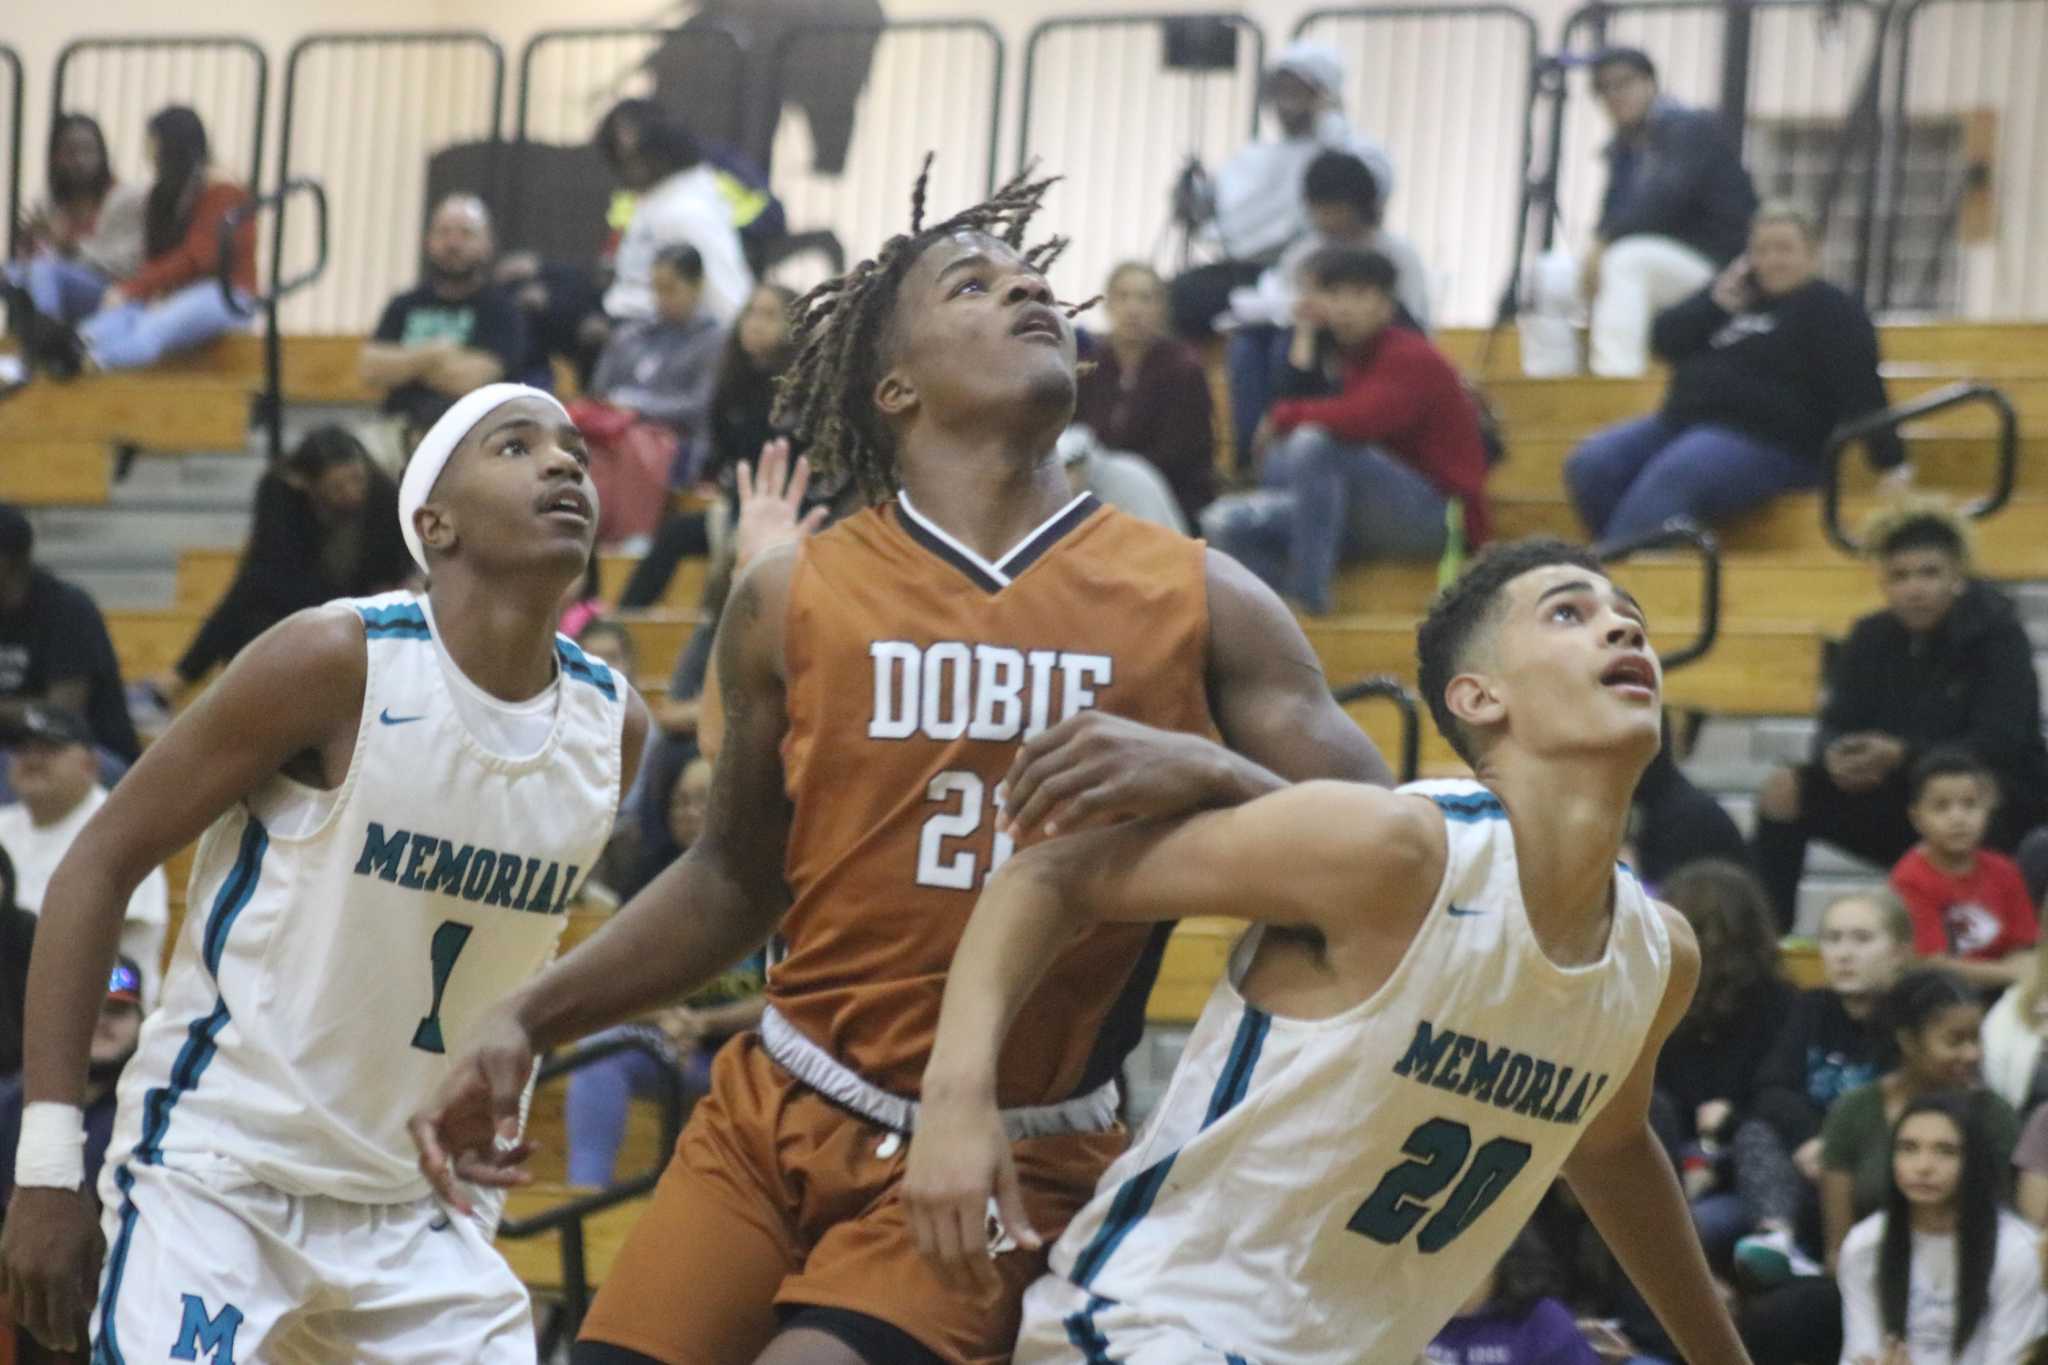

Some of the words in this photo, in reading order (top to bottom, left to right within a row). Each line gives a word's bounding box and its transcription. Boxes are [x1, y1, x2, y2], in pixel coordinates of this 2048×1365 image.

[868, 640, 1112, 741] DOBIE
[410, 920, 474, 1054] 1
[1346, 1116, 1532, 1254] 20
[169, 1292, 244, 1365] M
